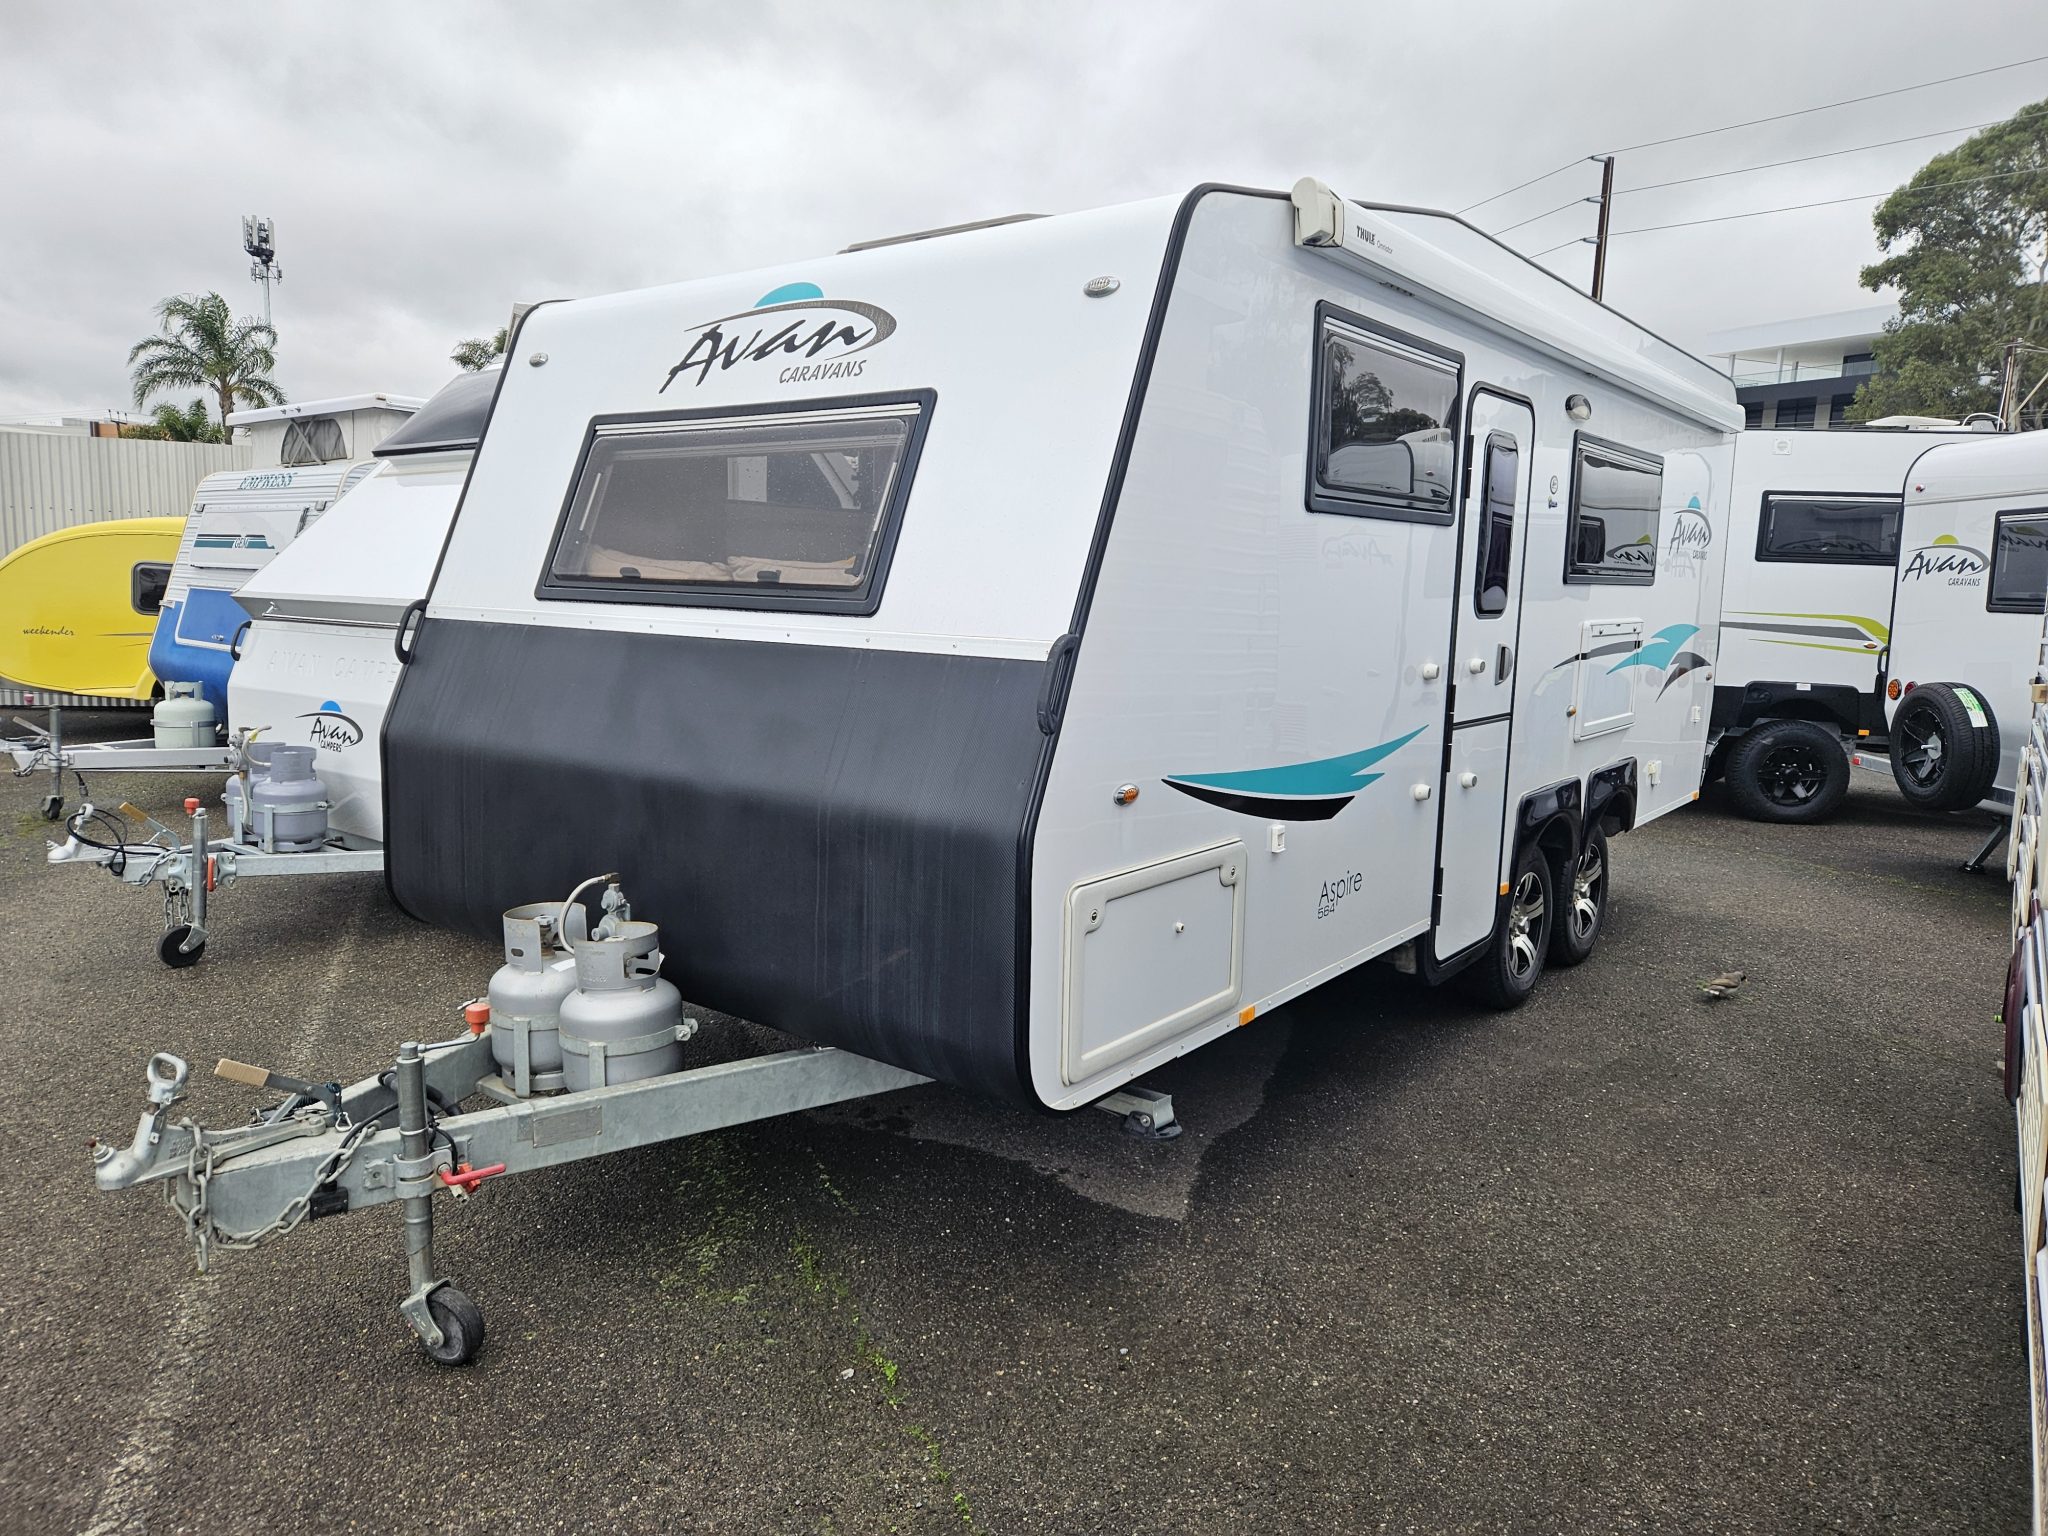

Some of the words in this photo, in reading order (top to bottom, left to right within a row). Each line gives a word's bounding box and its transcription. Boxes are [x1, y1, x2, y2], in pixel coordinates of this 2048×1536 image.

[1356, 225, 1376, 245] THULE
[658, 319, 873, 395] Avan
[778, 359, 867, 384] CARAVANS
[238, 472, 298, 491] EMPRESS
[1902, 550, 1983, 582] Avan
[1947, 578, 1981, 587] CARAVANS
[22, 625, 75, 636] weekender
[309, 716, 355, 744] Avan
[320, 739, 343, 753] CAMPERS
[1318, 870, 1363, 907] Aspire
